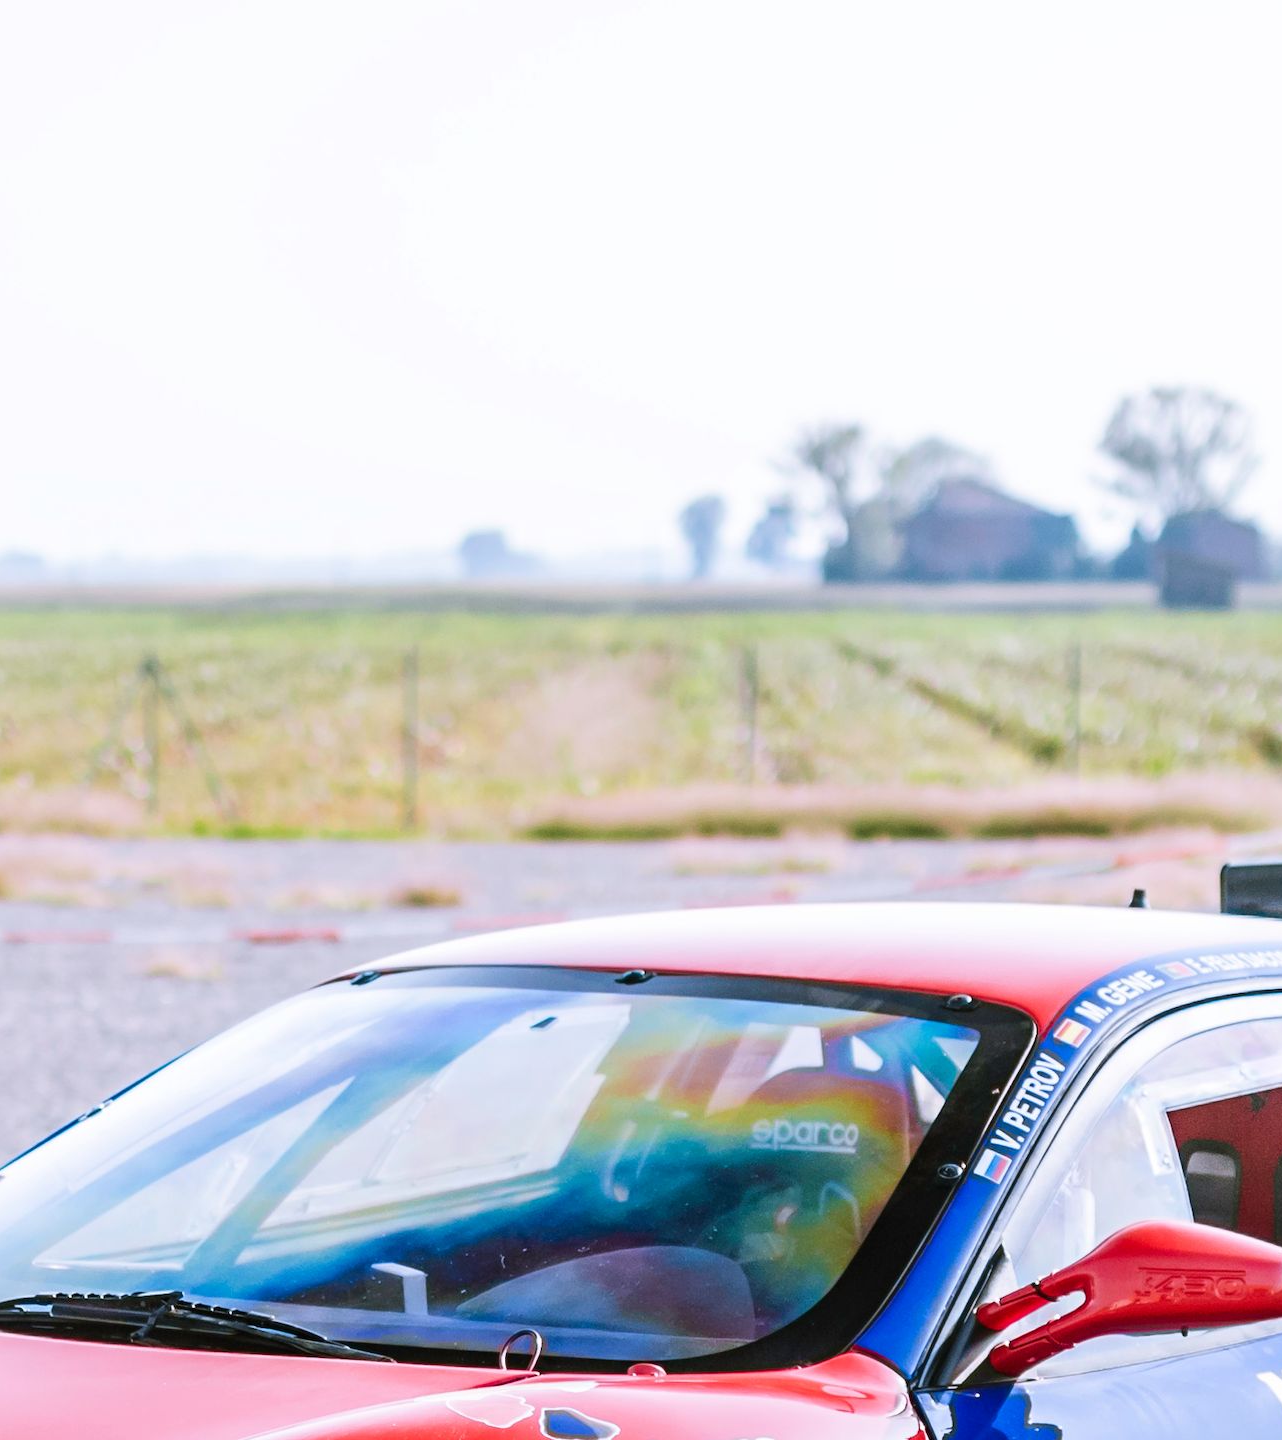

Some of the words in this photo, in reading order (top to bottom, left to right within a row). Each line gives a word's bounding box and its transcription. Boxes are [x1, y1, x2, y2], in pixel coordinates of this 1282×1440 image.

[1076, 993, 1113, 1024] M.
[1104, 970, 1165, 1007] GENE
[1003, 1053, 1066, 1134] PETROV
[752, 1118, 859, 1151] sparco
[990, 1127, 1022, 1151] V.
